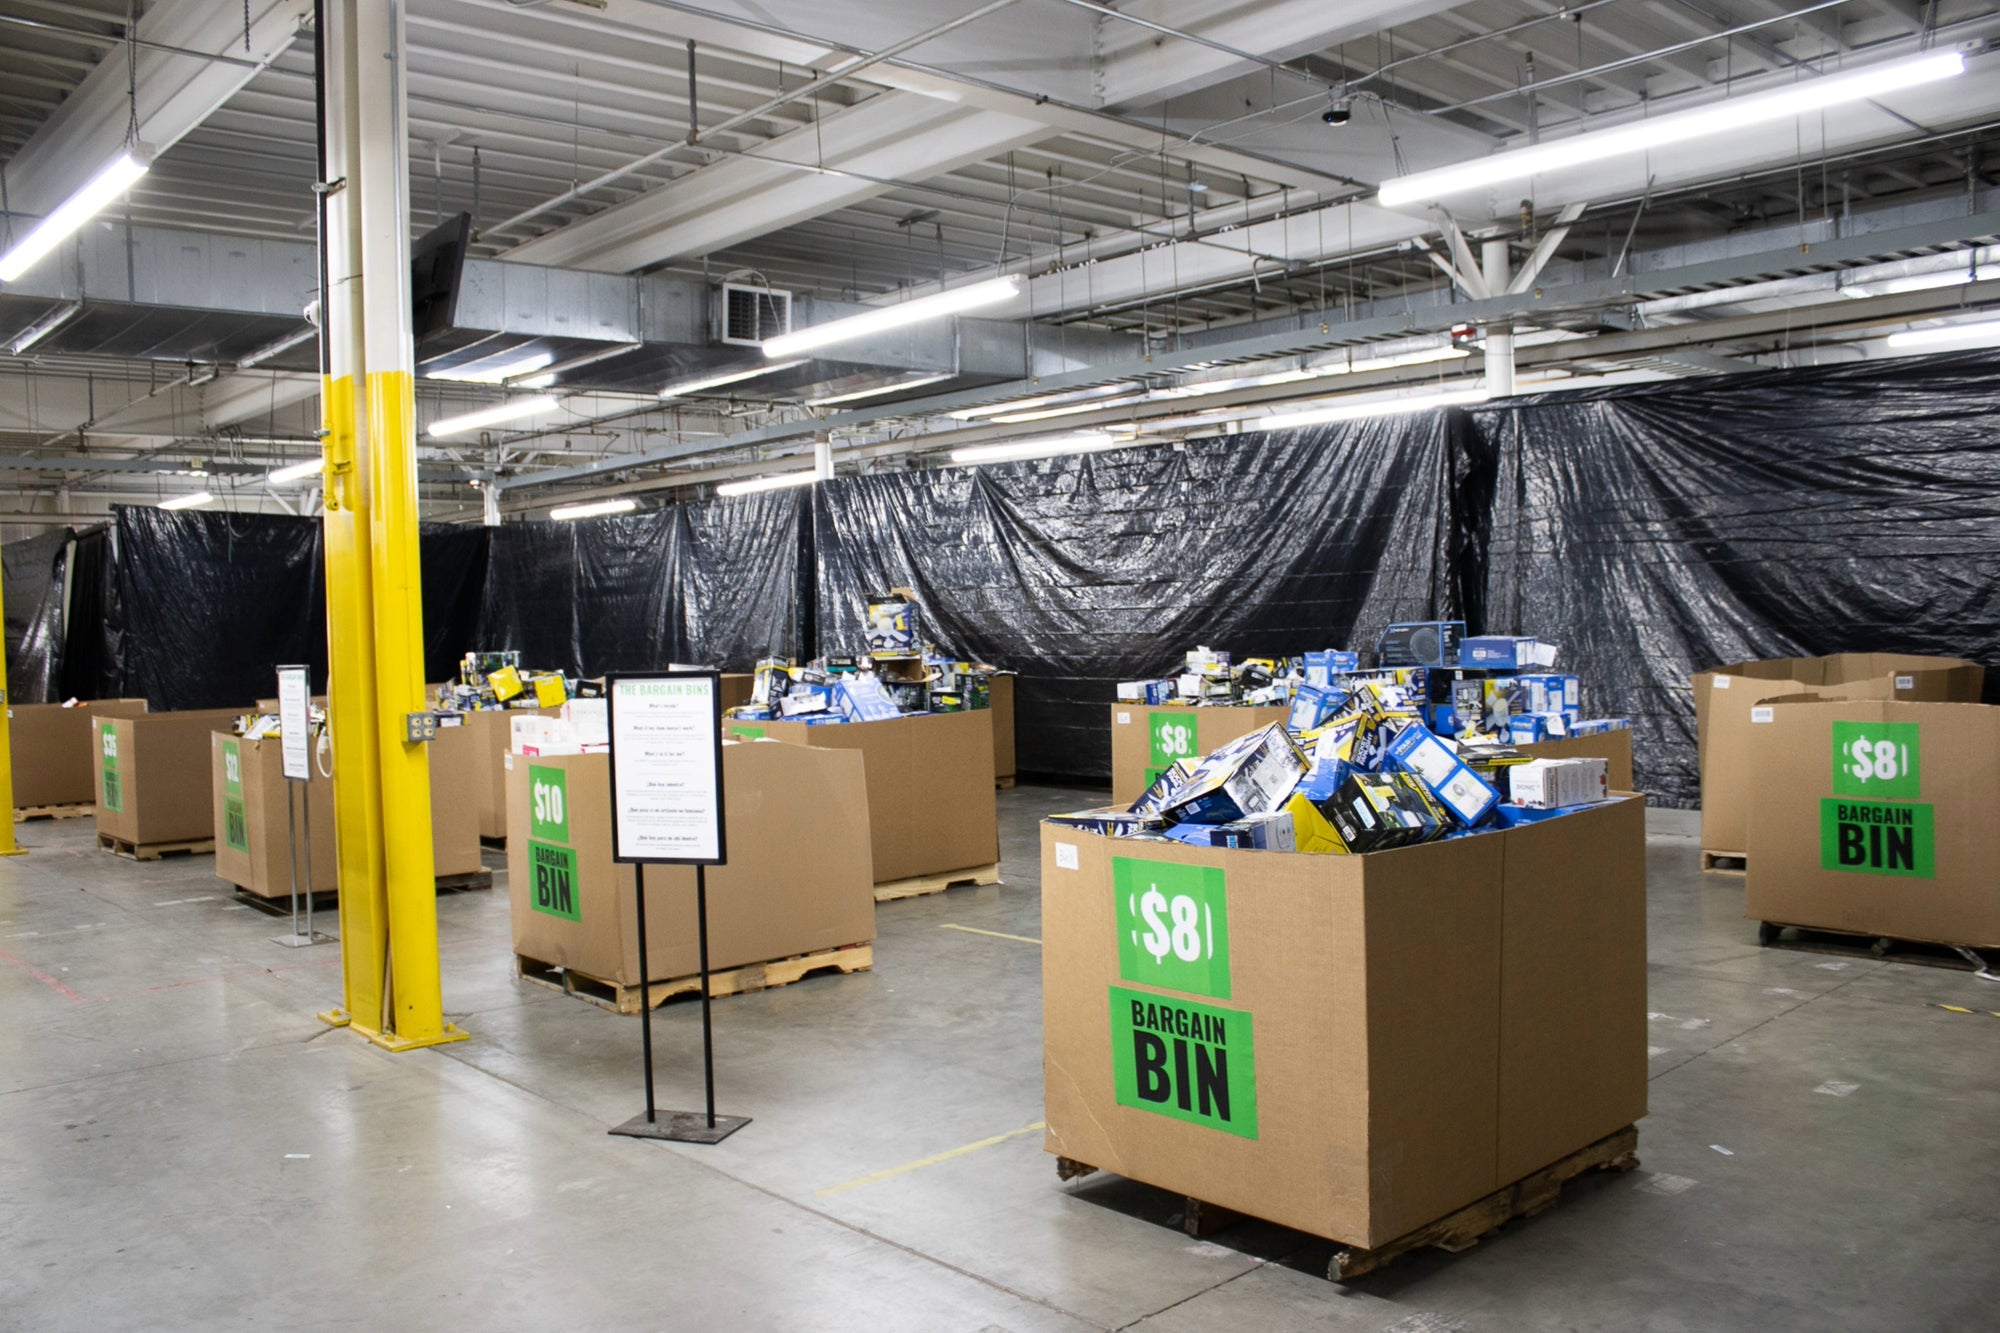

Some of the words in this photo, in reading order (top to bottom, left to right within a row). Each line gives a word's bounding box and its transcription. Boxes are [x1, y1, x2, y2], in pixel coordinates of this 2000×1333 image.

[620, 684, 636, 696] THE
[640, 684, 682, 696] BARGAIN
[686, 684, 709, 696] BINS
[1161, 721, 1188, 757] $8
[1852, 735, 1898, 783] $8
[534, 778, 563, 825] $10
[1837, 804, 1913, 826] BARGAIN
[229, 812, 246, 847] BIN
[1838, 822, 1915, 870] BIN
[535, 846, 569, 870] BARGAIN
[536, 864, 573, 914] BIN
[1140, 883, 1201, 965] $8
[1131, 999, 1227, 1046] BARGAIN
[1133, 1029, 1231, 1122] BIN
